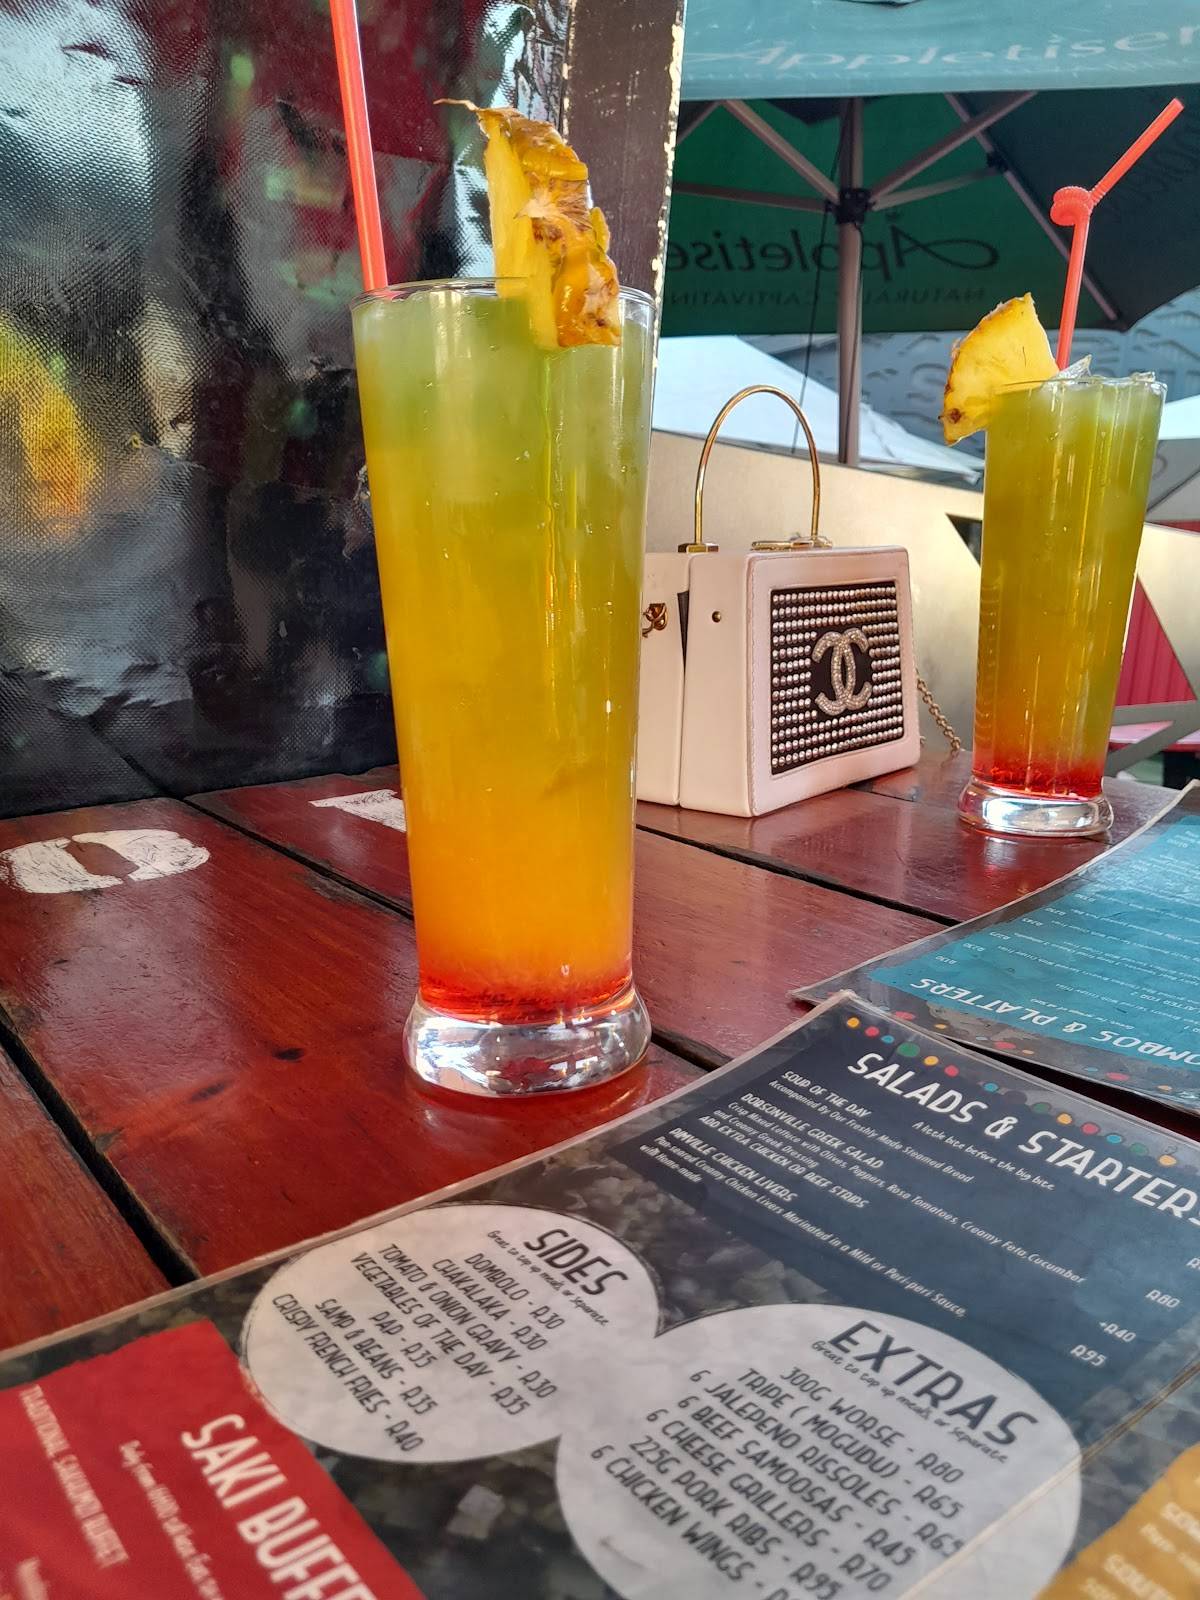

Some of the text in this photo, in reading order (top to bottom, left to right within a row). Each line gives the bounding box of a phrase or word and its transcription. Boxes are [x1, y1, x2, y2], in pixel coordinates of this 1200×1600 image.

[910, 977, 1059, 1028] PLATTERS
[1062, 1021, 1088, 1034] &
[713, 1109, 820, 1169] and Creamy Greek Dressing
[740, 1093, 885, 1169] DOBSONVILLE GREEK SALAD
[768, 1080, 975, 1183] Accompanied By Our Freshly Made Steamed Bread
[781, 1070, 872, 1118] SOUP OF THE DAY
[847, 1053, 1200, 1226] SALADS & STARTER
[699, 1115, 870, 1208] ADD EXTRA CHICKEN OR BEEF STRIPS
[711, 1152, 759, 1180] CHICKEN
[754, 1175, 798, 1202] LIVERS
[728, 1102, 749, 1116] Crisp
[747, 1112, 773, 1129] Mixed
[886, 1184, 912, 1200] Rosa
[960, 1221, 1003, 1246] Creamy
[912, 1121, 924, 1130] A
[965, 1145, 997, 1163] before
[997, 1161, 1016, 1173] the
[1015, 1168, 1032, 1181] big
[1031, 1175, 1056, 1191] bite
[487, 1230, 510, 1249] Great
[523, 1228, 628, 1295] SIDES
[695, 1160, 727, 1181] Creamy
[724, 1177, 759, 1199] Chicken
[755, 1195, 785, 1214] Livers
[782, 1210, 833, 1242] Marinated
[828, 1236, 842, 1248] in
[840, 1243, 851, 1252] a
[848, 1248, 876, 1265] Mild
[871, 1261, 886, 1271] or
[315, 1298, 356, 1329] SAMP
[344, 1328, 365, 1341] &
[350, 1252, 424, 1315] VEGETABLES
[412, 1313, 441, 1328] OF
[430, 1327, 466, 1355] THE
[453, 1351, 494, 1379] DAY
[490, 1386, 531, 1416] R35
[378, 1243, 428, 1283] TOMATO
[418, 1281, 438, 1292] &
[428, 1290, 477, 1326] ONION
[465, 1323, 521, 1363] GRAVY
[517, 1370, 558, 1399] R30
[432, 1258, 511, 1322] CHAKALAKA
[510, 1325, 549, 1351] R30
[464, 1252, 530, 1301] DOMBOLO
[529, 1305, 565, 1330] R30
[271, 1293, 320, 1333] CRISPY
[304, 1330, 360, 1379] FRENCH
[344, 1374, 391, 1414] FRIES
[384, 1419, 425, 1452] R40
[352, 1337, 405, 1380] BEANS
[368, 1310, 405, 1336] PAP
[401, 1342, 438, 1369] R35
[810, 1340, 842, 1366] Great
[844, 1363, 859, 1374] to
[860, 1372, 881, 1389] top
[880, 1385, 896, 1398] up
[828, 1320, 1039, 1445] EXTRAS
[1070, 1344, 1107, 1367] R95
[399, 1385, 438, 1415] R35
[736, 1367, 795, 1409] TRIPE
[912, 1484, 965, 1520] R65
[779, 1366, 832, 1402] 300G
[828, 1397, 905, 1449] WORSE
[914, 1452, 965, 1484] R80
[181, 1413, 288, 1510] SAKI
[645, 1408, 669, 1423] 6
[661, 1419, 736, 1477] CHEESE
[728, 1472, 830, 1548] GRILLERS
[838, 1553, 893, 1592] R70
[677, 1395, 700, 1409] 6
[690, 1405, 744, 1441] BEEF
[735, 1439, 854, 1523] SAMOOSAS
[863, 1527, 917, 1566] R45
[689, 1369, 712, 1382] 6
[703, 1382, 802, 1449] JALEPENO
[796, 1445, 902, 1517] RISSOLES
[912, 1522, 965, 1558] R65
[590, 1444, 615, 1460] 6
[605, 1457, 689, 1527] CHICKEN
[680, 1521, 756, 1581] WINGS
[628, 1435, 681, 1474] 225G
[671, 1469, 735, 1518] PORK
[724, 1512, 782, 1556] RIBS
[789, 1562, 844, 1600] R95
